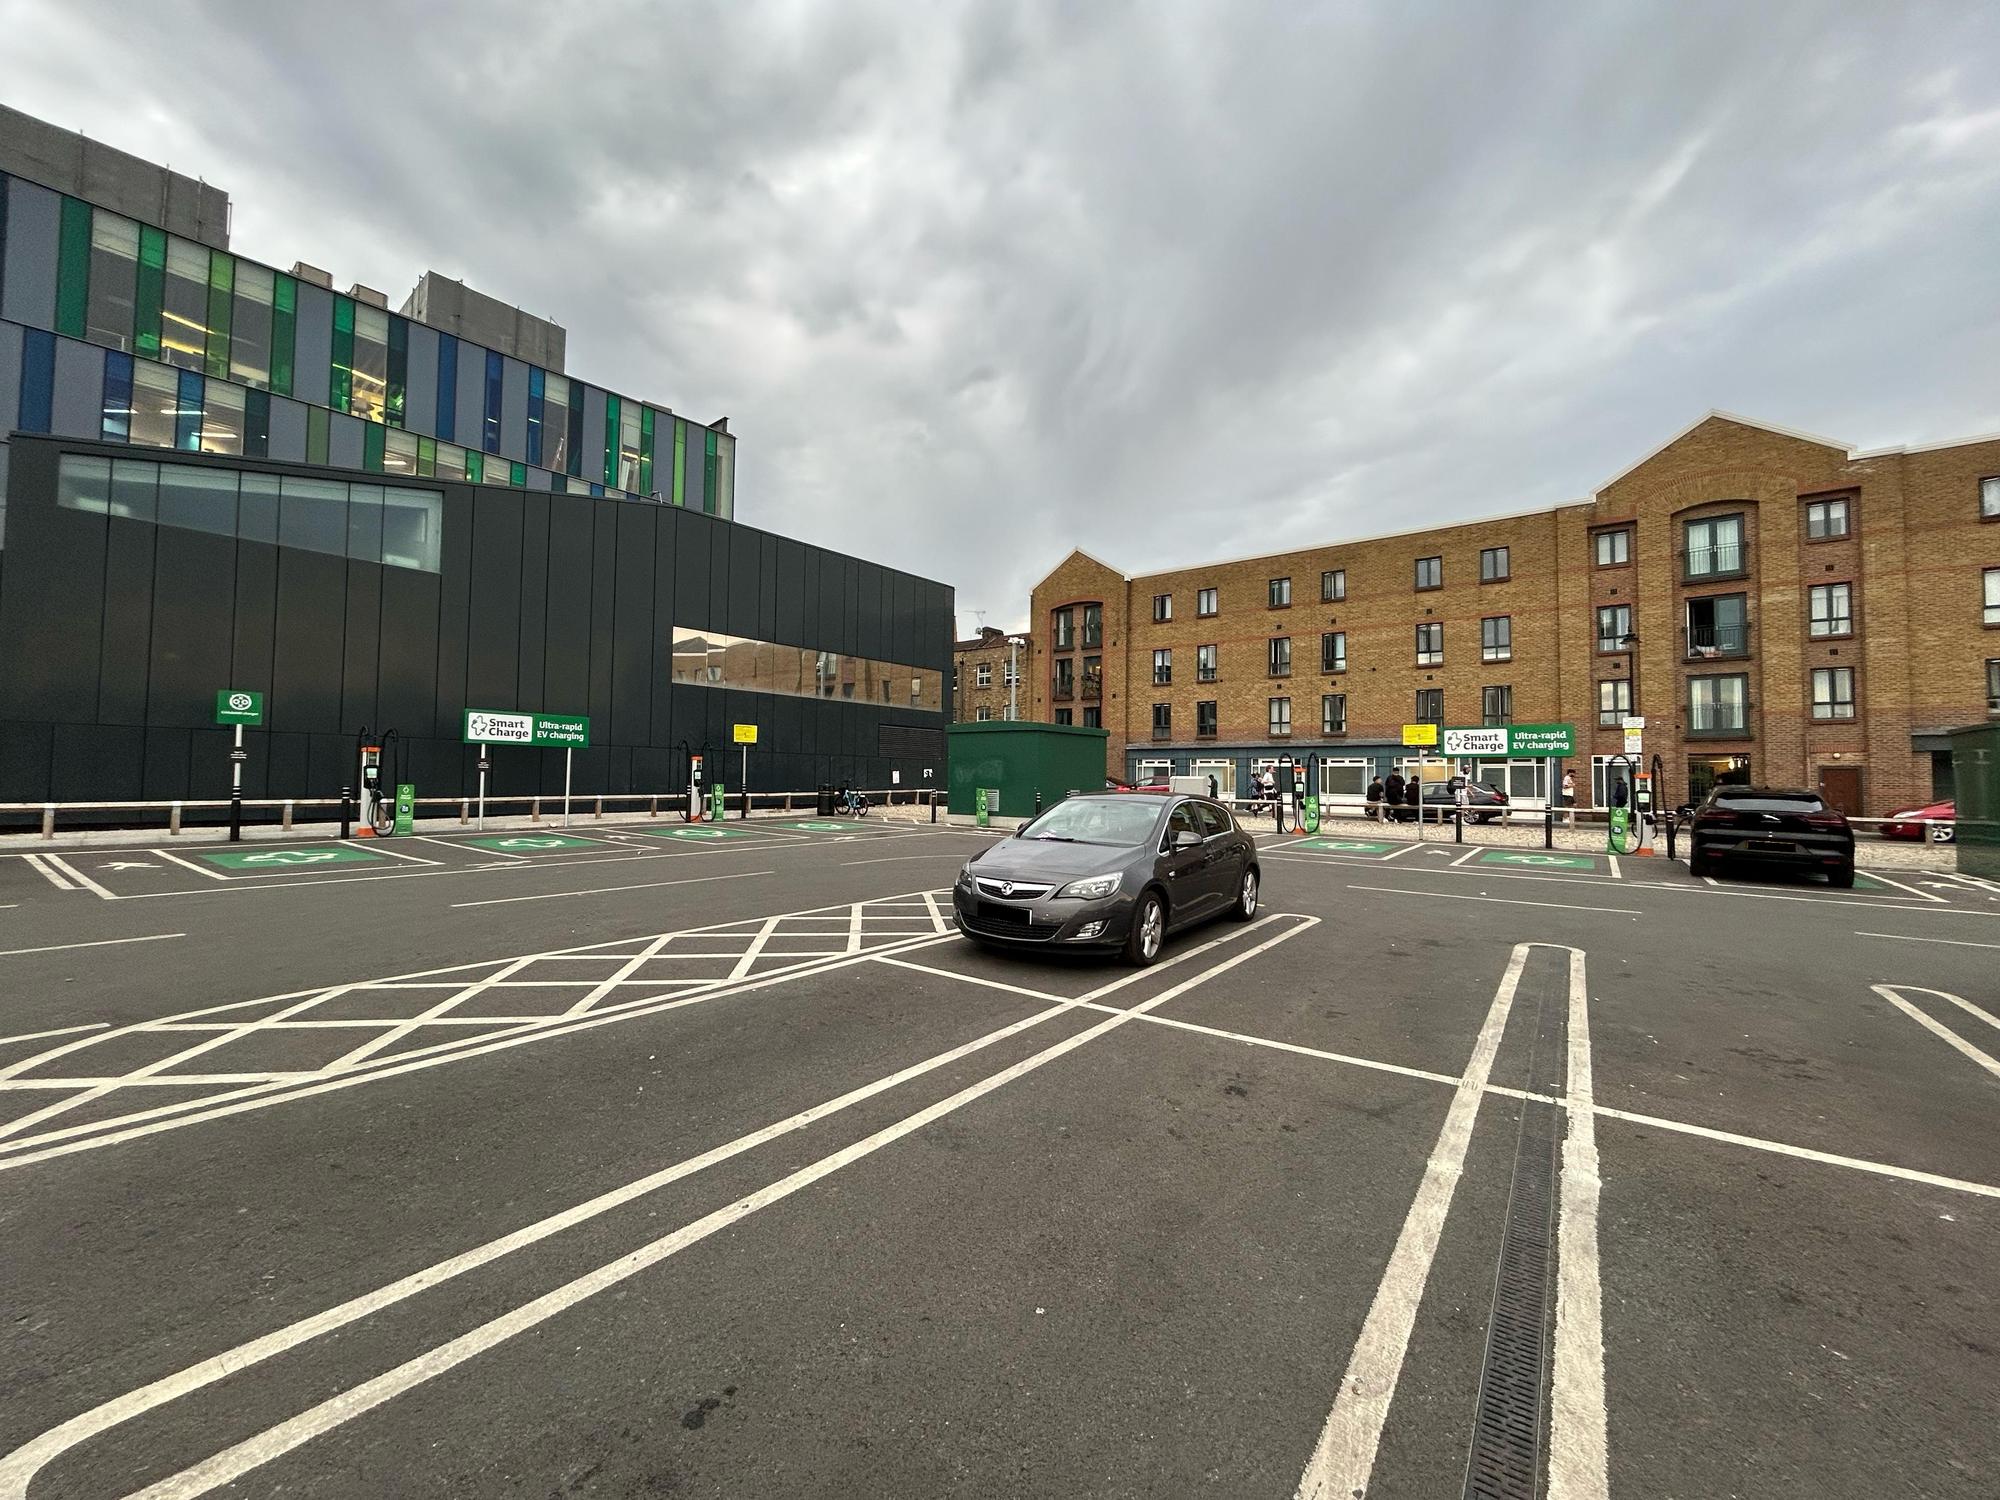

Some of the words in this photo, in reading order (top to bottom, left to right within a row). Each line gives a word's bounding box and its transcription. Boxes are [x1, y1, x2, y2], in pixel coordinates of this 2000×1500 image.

[489, 718, 524, 728] Smart
[539, 721, 583, 732] Ultra-rapid
[488, 728, 529, 739] Charge
[549, 731, 584, 742] charging
[1463, 733, 1499, 742] Smart
[1514, 731, 1567, 740] Ultra-rapid
[1463, 742, 1504, 752] Charge
[1527, 740, 1569, 751] charging
